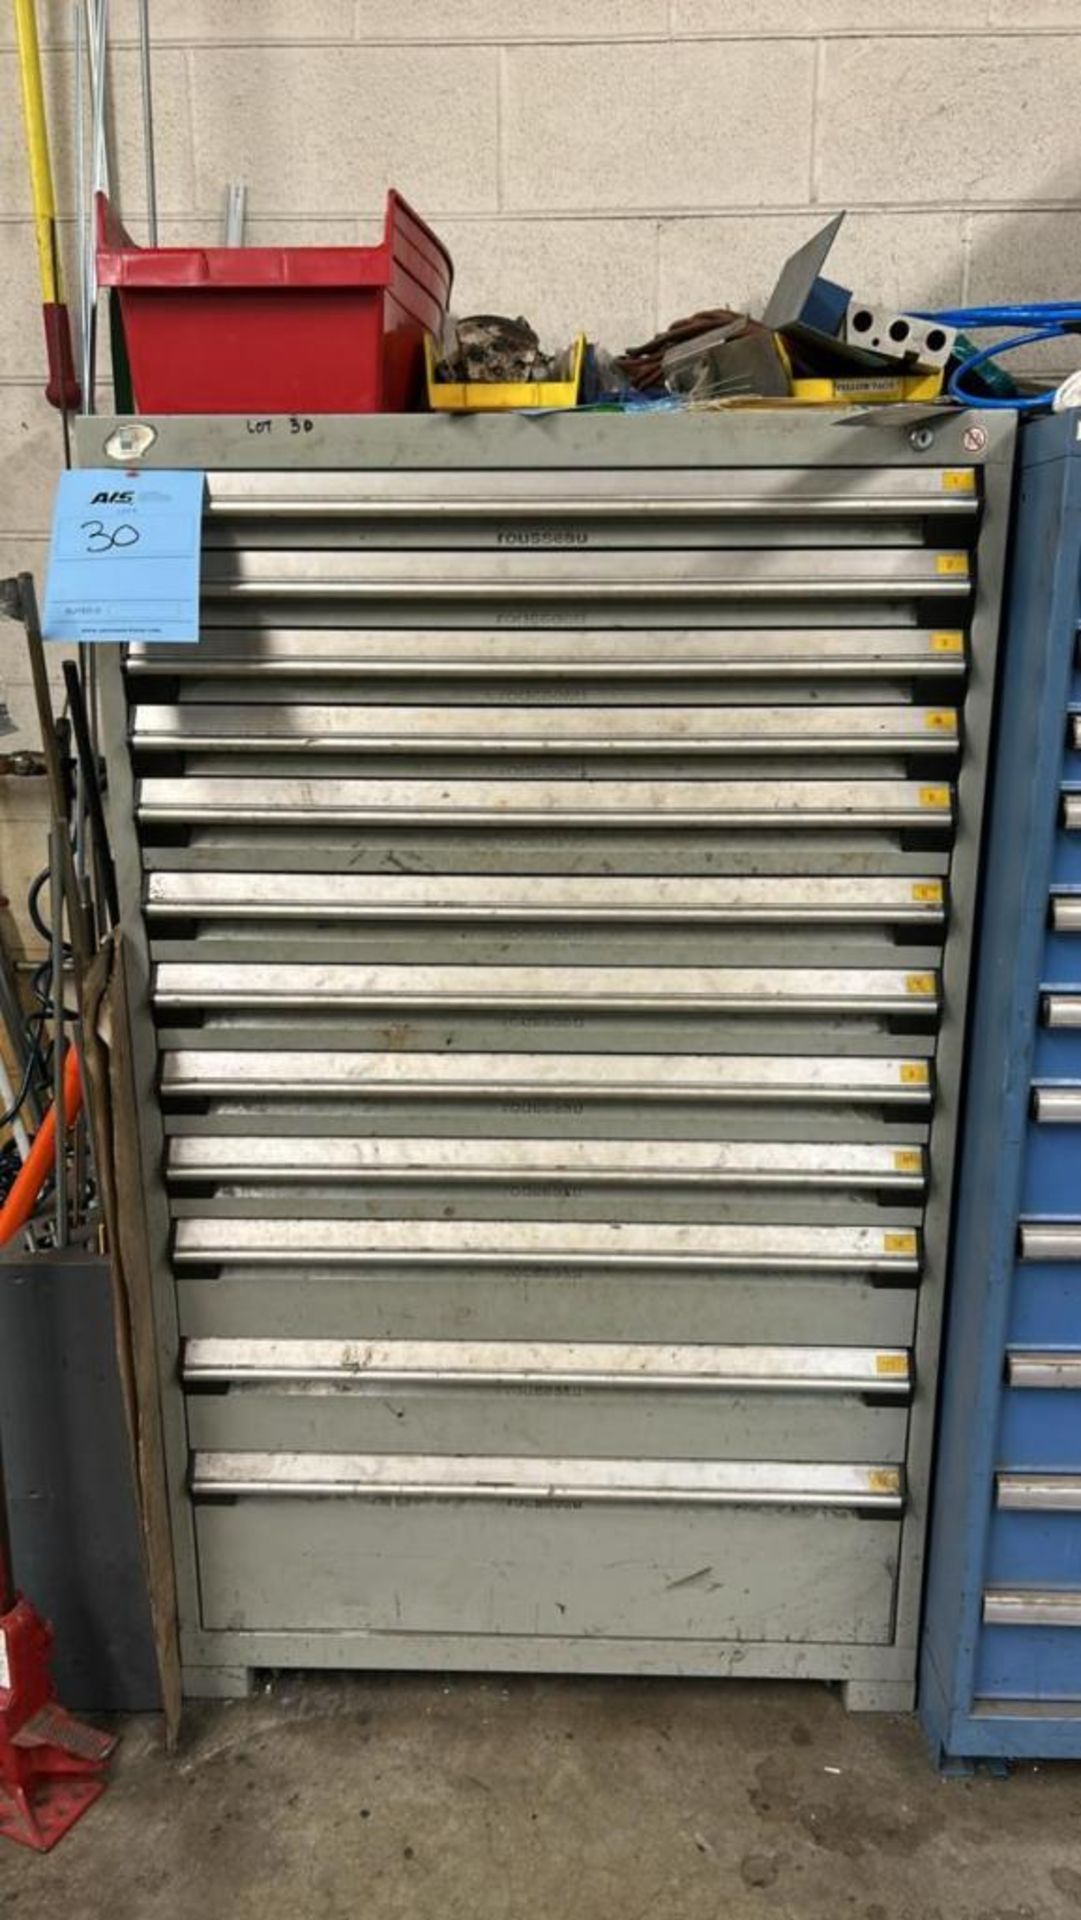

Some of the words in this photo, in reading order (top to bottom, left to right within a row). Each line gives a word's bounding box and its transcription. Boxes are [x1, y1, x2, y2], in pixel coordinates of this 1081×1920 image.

[247, 420, 272, 434] LOT
[290, 419, 314, 434] 30
[90, 490, 135, 505] AIS
[81, 520, 140, 553] 30
[497, 530, 589, 545] rousseau
